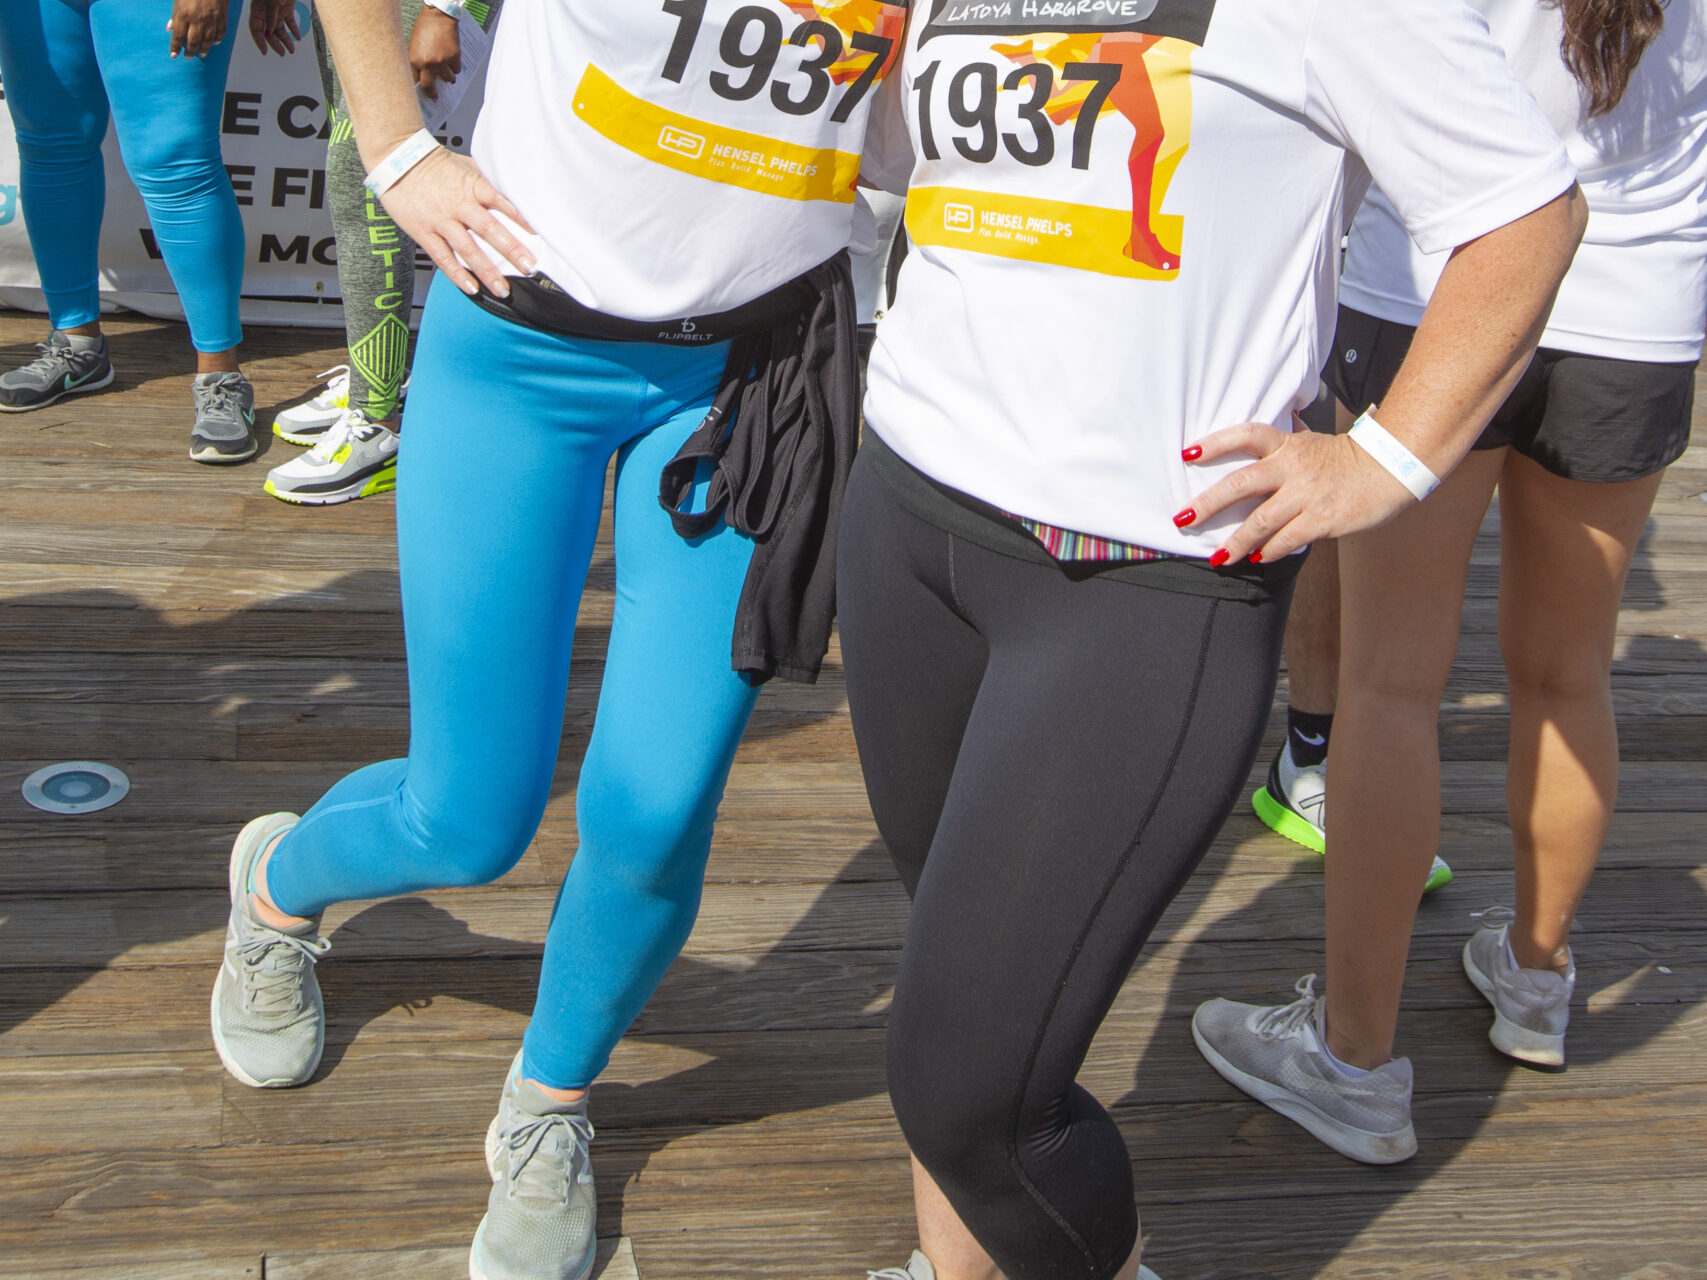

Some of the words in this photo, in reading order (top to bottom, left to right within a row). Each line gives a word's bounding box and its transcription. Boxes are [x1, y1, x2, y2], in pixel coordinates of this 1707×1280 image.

[948, 1, 1012, 22] LATOYA
[912, 60, 1124, 171] 1937
[712, 143, 766, 167] HENSEL
[769, 156, 819, 177] PHELPS
[980, 210, 1024, 230] HENSEL
[1025, 216, 1073, 238] PHELPS
[365, 189, 404, 310] LETIC
[657, 332, 714, 341] FLIPBELT
